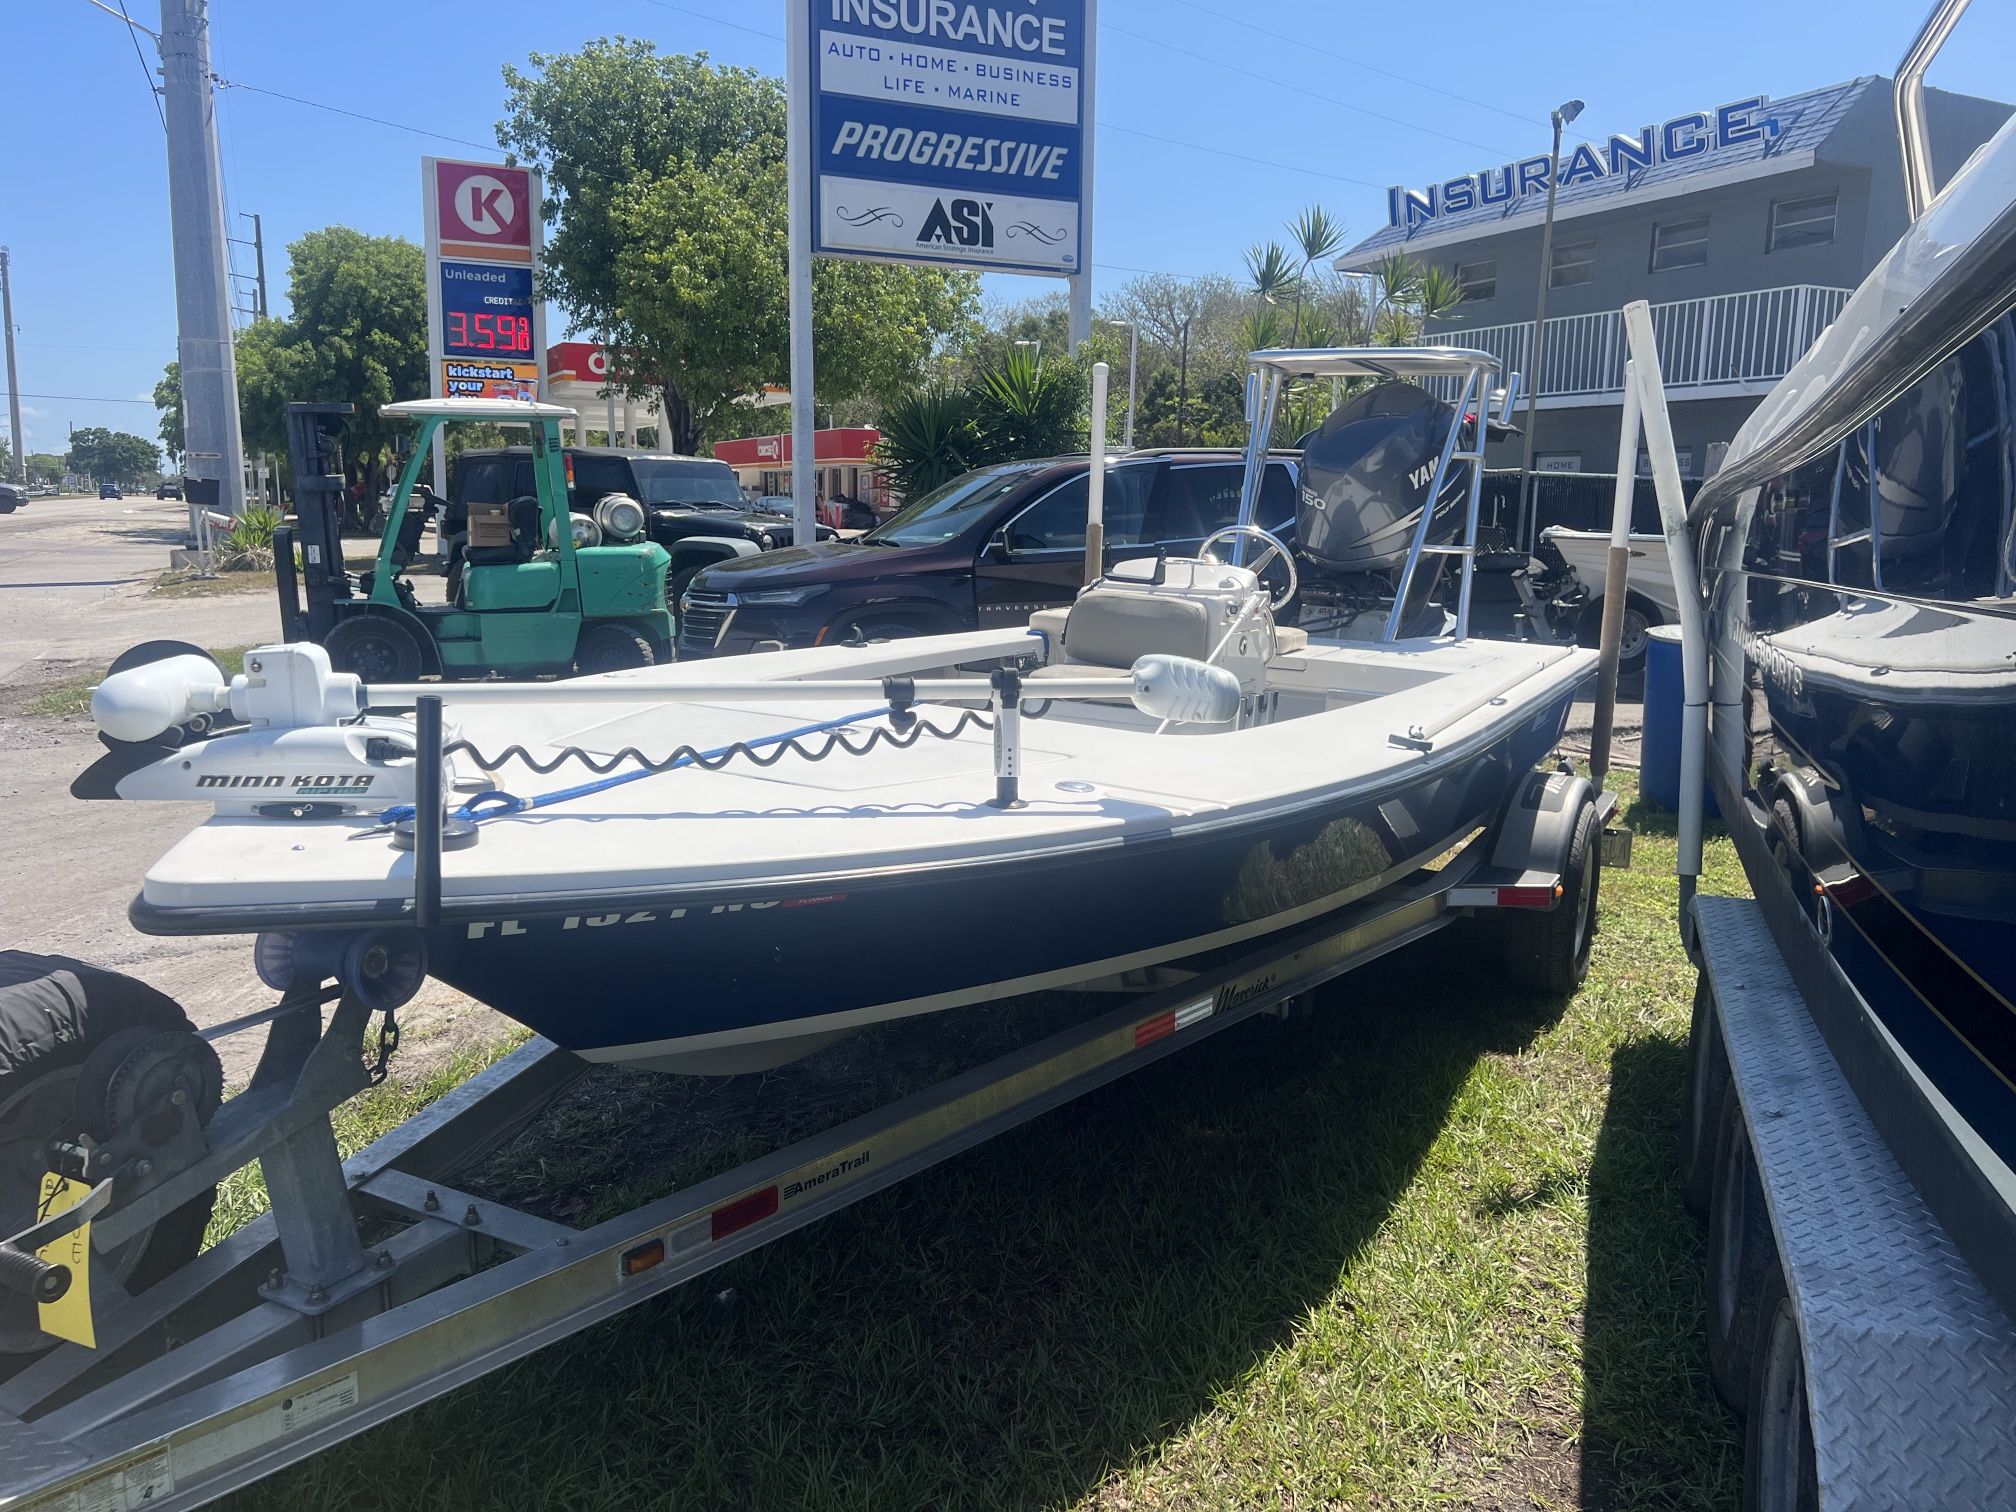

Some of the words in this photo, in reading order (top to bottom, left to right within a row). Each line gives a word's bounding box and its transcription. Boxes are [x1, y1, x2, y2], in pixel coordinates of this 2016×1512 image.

[831, 0, 1067, 56] INSURANCE
[827, 41, 881, 62] AUTO
[900, 53, 957, 73] HOME
[976, 63, 1072, 89] BUSINESS
[884, 75, 925, 94] LIFE
[948, 85, 1021, 107] MARINE
[831, 120, 1069, 180] PROGRESSIVE
[1386, 94, 1766, 228] INSURANCE
[470, 186, 508, 228] K
[915, 197, 994, 249] ASI
[915, 242, 943, 251] American
[968, 246, 994, 255] Insurance
[445, 269, 506, 284] Unleaded
[484, 296, 513, 305] CREDIT
[447, 364, 513, 379] kickstart
[448, 381, 483, 392] your
[1546, 461, 1574, 470] HOME
[1301, 490, 1326, 510] 150
[196, 775, 286, 788] MINN
[290, 775, 375, 787] KOTA
[791, 1150, 870, 1195] AmeraTrail
